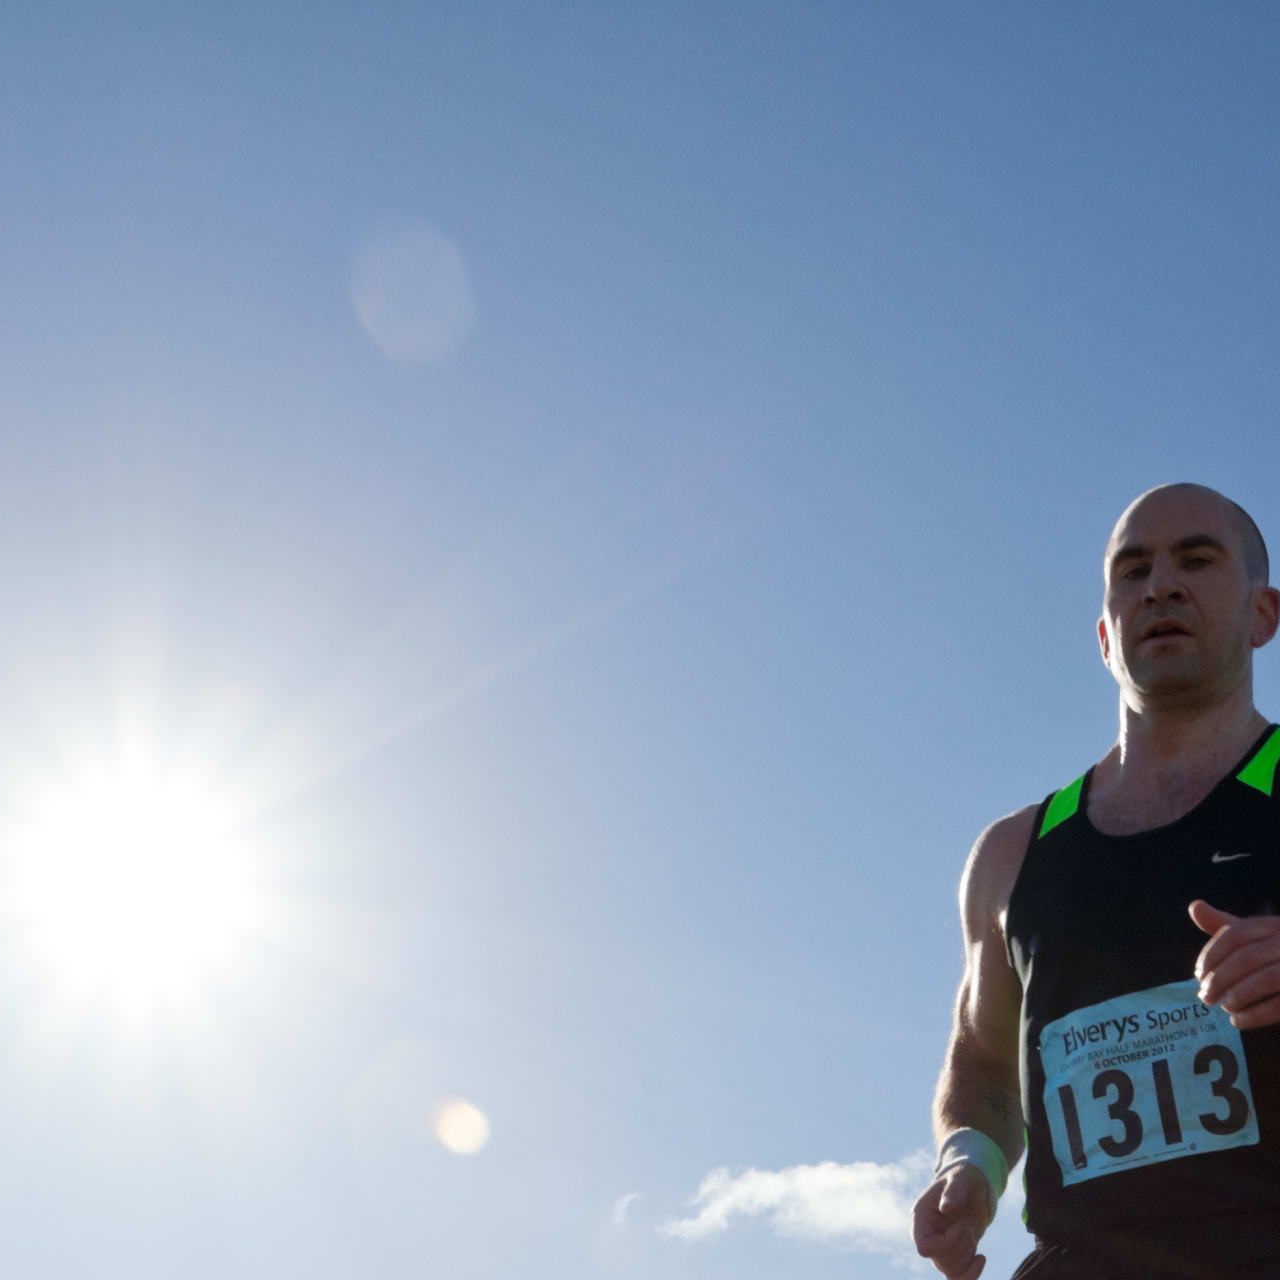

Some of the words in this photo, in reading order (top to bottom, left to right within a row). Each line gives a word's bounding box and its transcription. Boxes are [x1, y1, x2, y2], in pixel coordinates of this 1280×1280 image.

[1062, 1013, 1140, 1056] Elverys
[1146, 1003, 1210, 1030] Sports
[1087, 1048, 1105, 1060] BAY
[1106, 1043, 1130, 1056] HALF
[1132, 1030, 1187, 1049] MARATHON
[1102, 1050, 1149, 1067] OCTOBER
[1151, 1044, 1175, 1056] 2012
[1057, 1044, 1249, 1170] 1313
